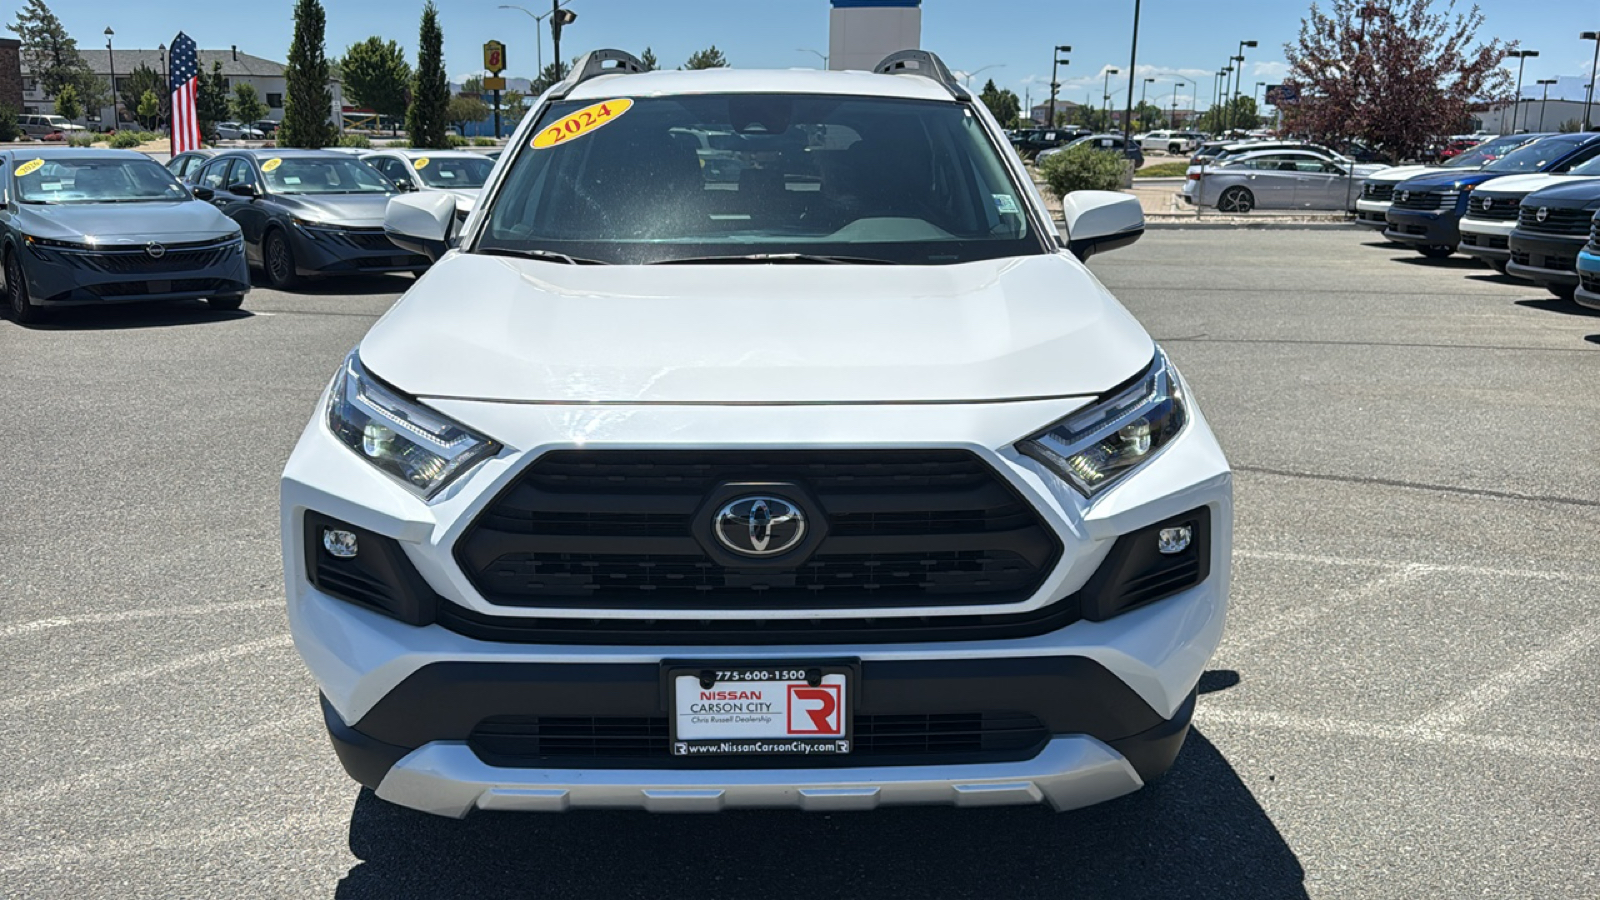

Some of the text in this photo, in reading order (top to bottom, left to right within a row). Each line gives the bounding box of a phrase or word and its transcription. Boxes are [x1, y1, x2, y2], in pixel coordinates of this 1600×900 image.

[489, 50, 500, 65] 8
[547, 103, 612, 144] 2024
[715, 670, 806, 680] 775-600-1500
[699, 691, 762, 700] NISSAN
[690, 702, 772, 713] CARSON CITY
[793, 689, 836, 731] R
[690, 716, 709, 724] Chris
[735, 715, 772, 724] Dealership
[689, 741, 835, 754] www.NissanCarsonCity.com
